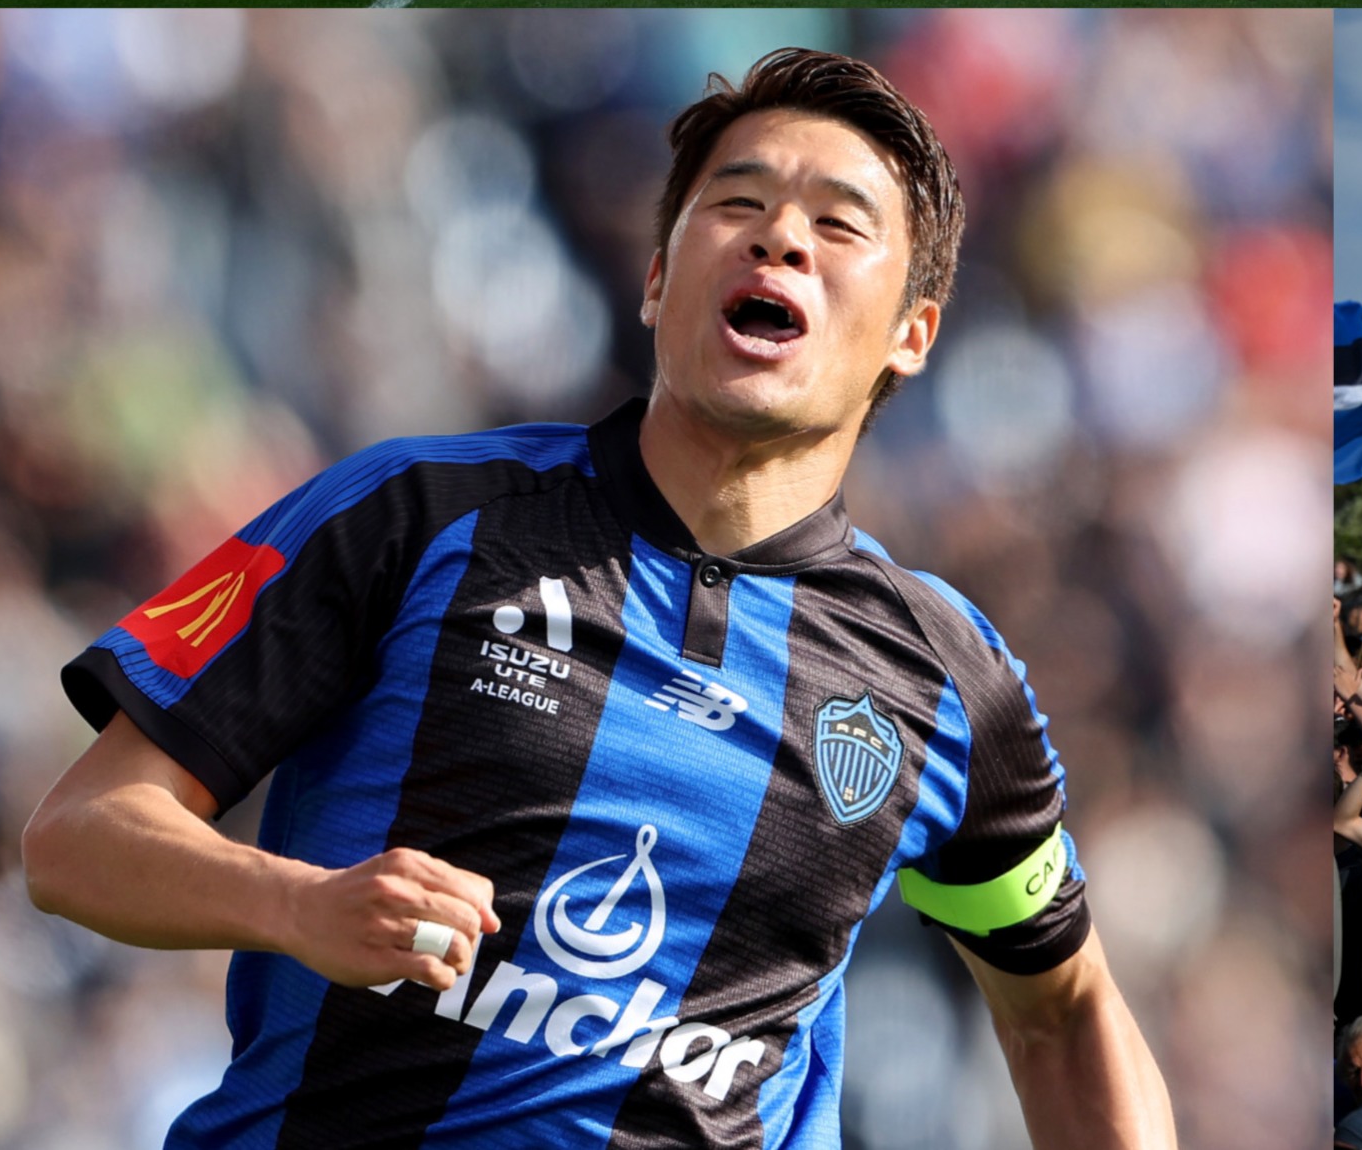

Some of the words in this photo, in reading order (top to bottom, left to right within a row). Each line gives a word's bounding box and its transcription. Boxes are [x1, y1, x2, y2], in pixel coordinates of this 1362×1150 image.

[480, 640, 570, 679] ISUZU
[494, 663, 547, 689] UTE
[470, 678, 560, 715] A-LEAGUE
